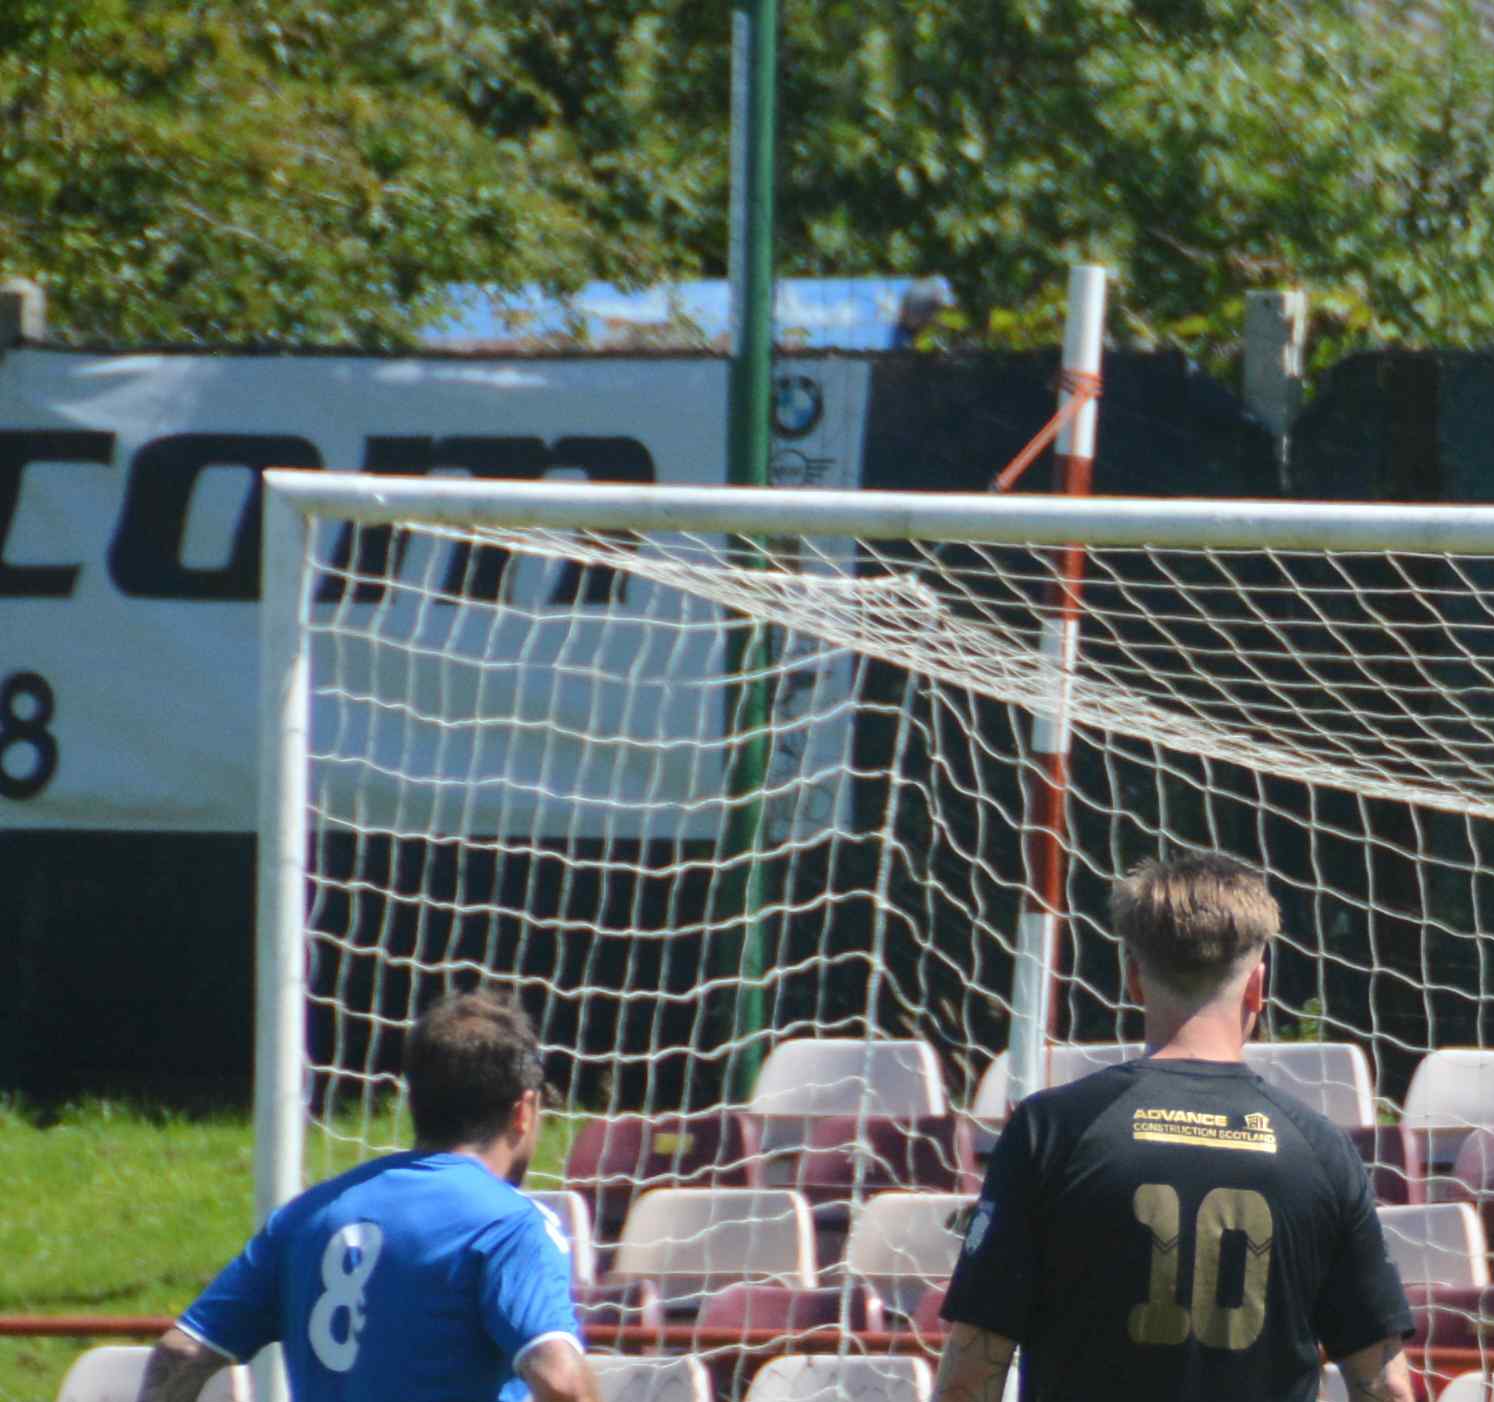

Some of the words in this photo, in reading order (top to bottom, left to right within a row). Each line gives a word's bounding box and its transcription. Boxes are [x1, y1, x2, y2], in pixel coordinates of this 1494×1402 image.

[1133, 1109, 1228, 1127] ADVANCE
[1133, 1122, 1217, 1138] CONSTRUCTION
[1219, 1130, 1276, 1145] SCOTLAND
[308, 1222, 383, 1373] 8
[1127, 1183, 1274, 1350] 10
